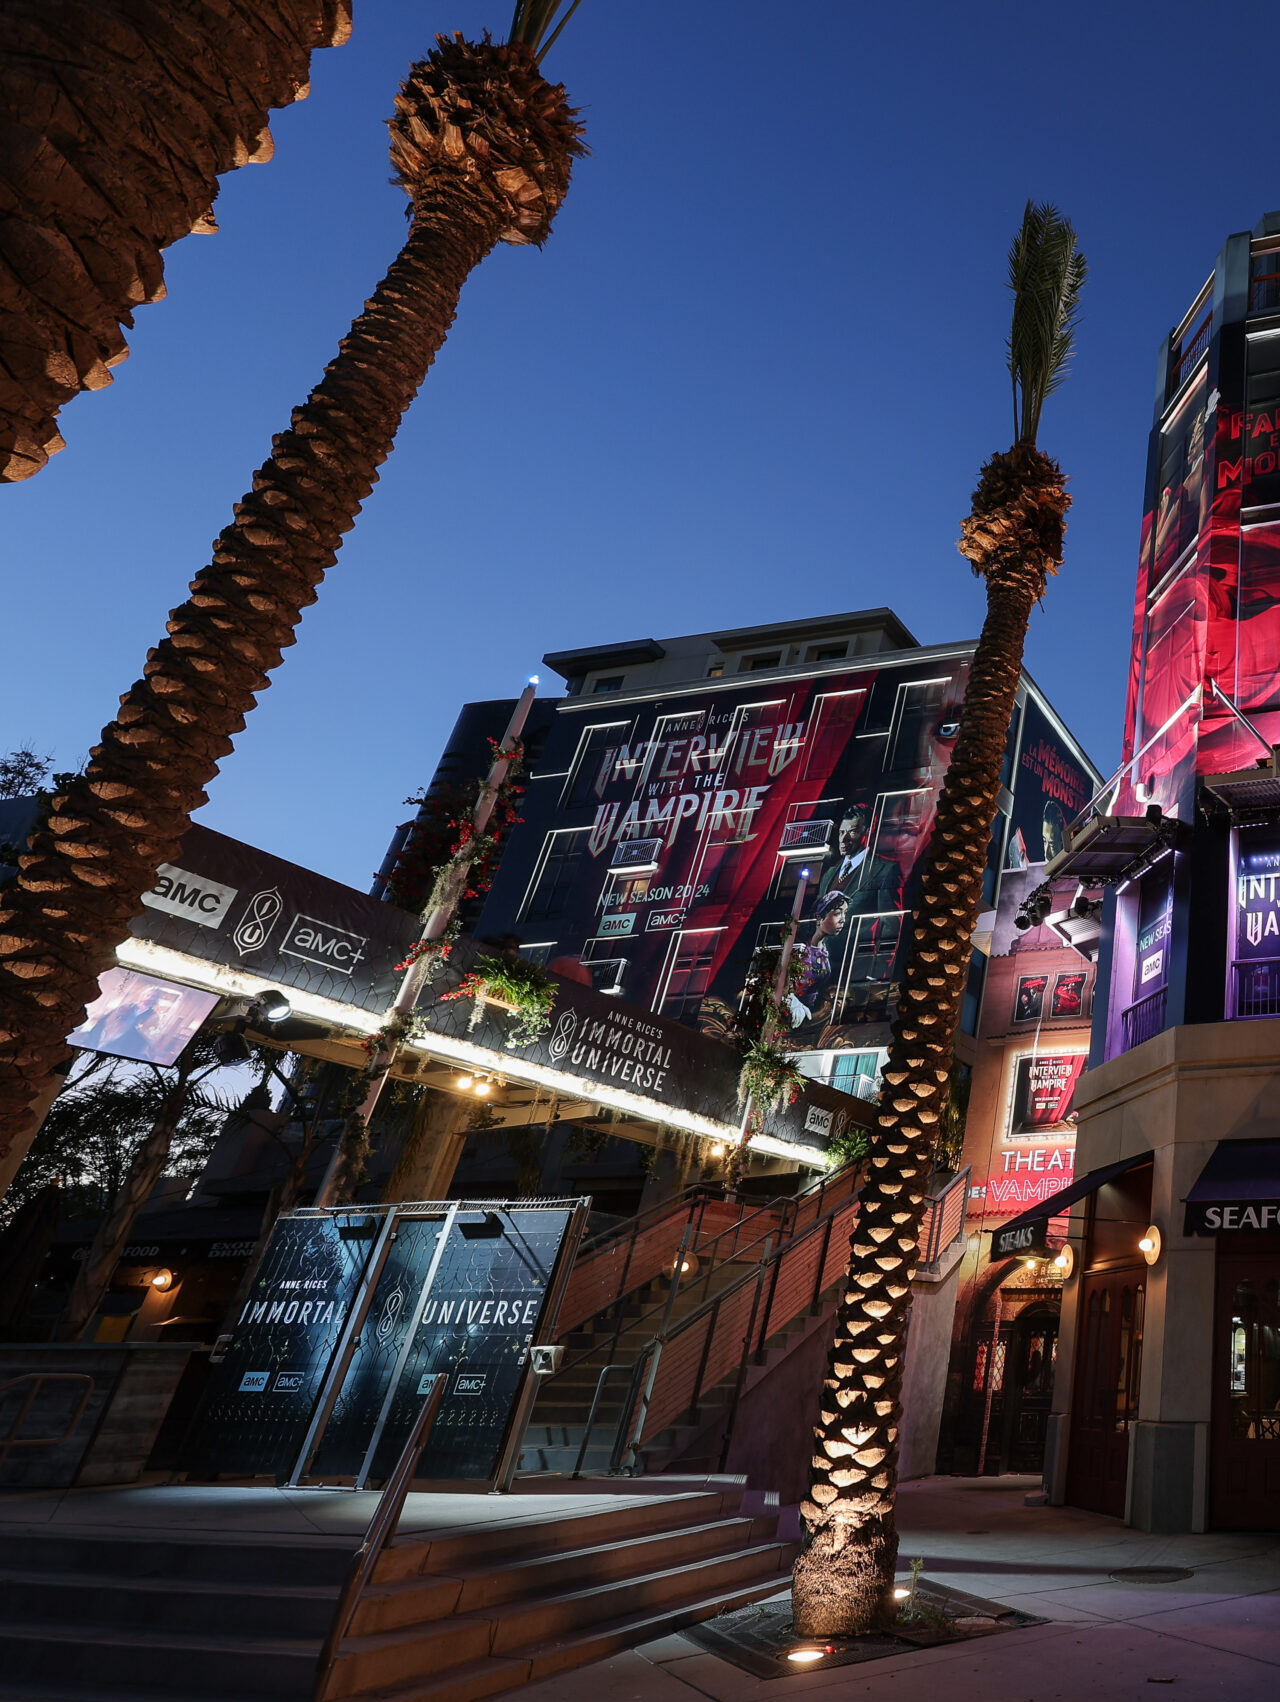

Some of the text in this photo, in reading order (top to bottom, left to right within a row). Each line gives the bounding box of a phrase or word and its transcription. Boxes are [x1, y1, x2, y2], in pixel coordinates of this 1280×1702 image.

[665, 712, 750, 733] ANNE RICES
[594, 722, 806, 799] INTERVIEW
[694, 773, 724, 788] THE
[588, 784, 772, 858] VAMPIRE
[599, 884, 711, 907] NEW SEASON 2024
[1139, 932, 1154, 953] NEW
[607, 1010, 664, 1040] ANNE RICE'S
[577, 1016, 672, 1070] IMMORTAL
[570, 1041, 668, 1093] UNIVERSE
[1028, 1065, 1073, 1079] INTERVIEW
[1030, 1078, 1068, 1093] VAMPIRE
[999, 1227, 1034, 1252] STEAKS
[237, 1299, 347, 1326] IMMORTAL
[421, 1298, 538, 1326] UNIVERSE
